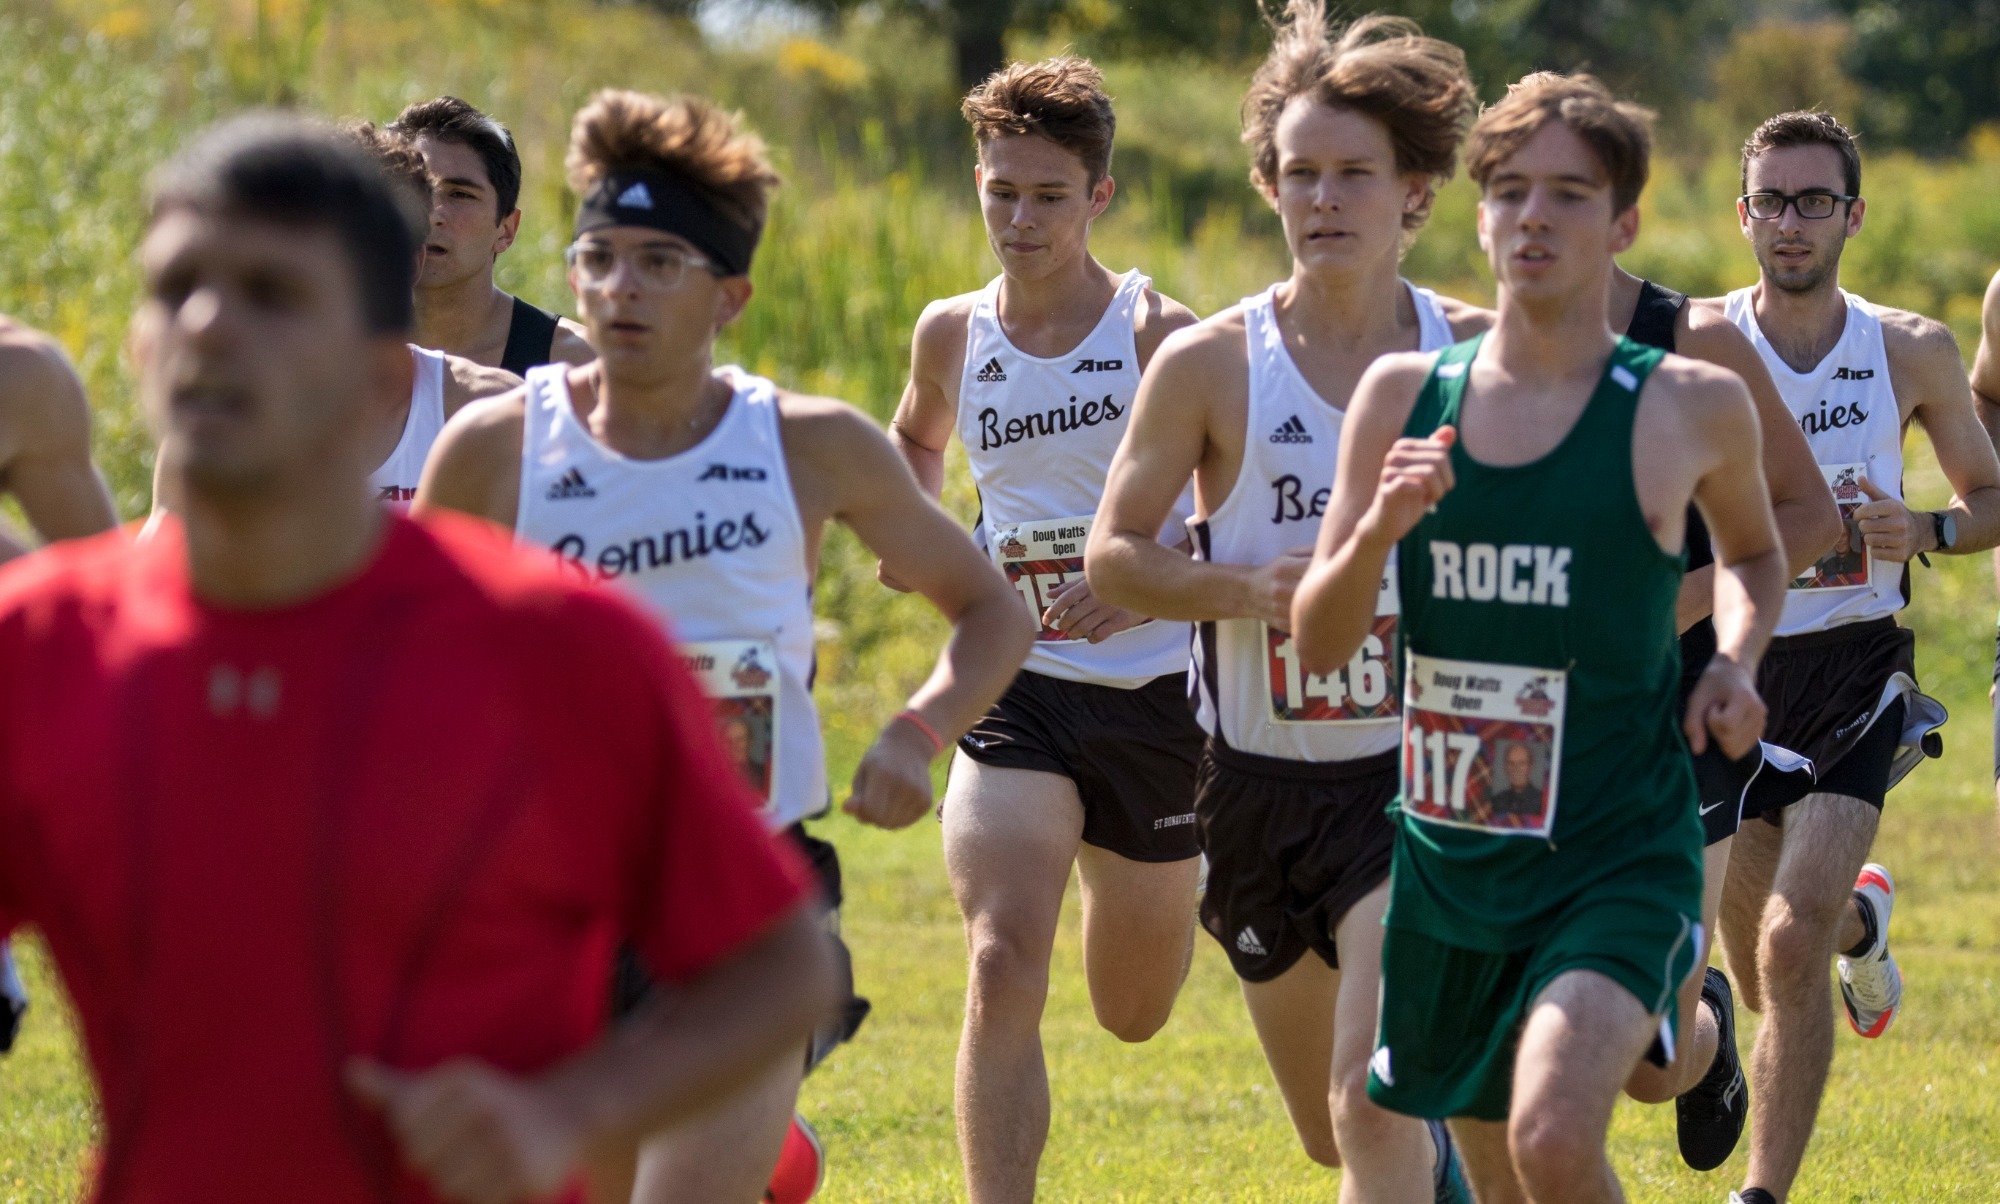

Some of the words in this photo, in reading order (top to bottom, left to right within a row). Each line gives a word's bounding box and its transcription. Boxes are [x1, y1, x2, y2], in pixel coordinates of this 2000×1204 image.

[1071, 359, 1123, 373] A10
[1831, 367, 1875, 381] A10
[977, 373, 1007, 382] adidas
[978, 394, 1125, 450] Bonnies
[1798, 400, 1869, 435] nies
[1269, 433, 1313, 444] adidas
[696, 463, 768, 482] A10
[1033, 530, 1056, 542] Doug
[1058, 526, 1086, 540] Watts
[552, 511, 769, 580] Bonnies
[1053, 543, 1076, 556] Open
[1430, 540, 1573, 607] ROCK
[1015, 571, 1087, 632] 15
[1275, 634, 1386, 708] 146
[1465, 674, 1502, 693] Watts
[1409, 724, 1481, 810] 117
